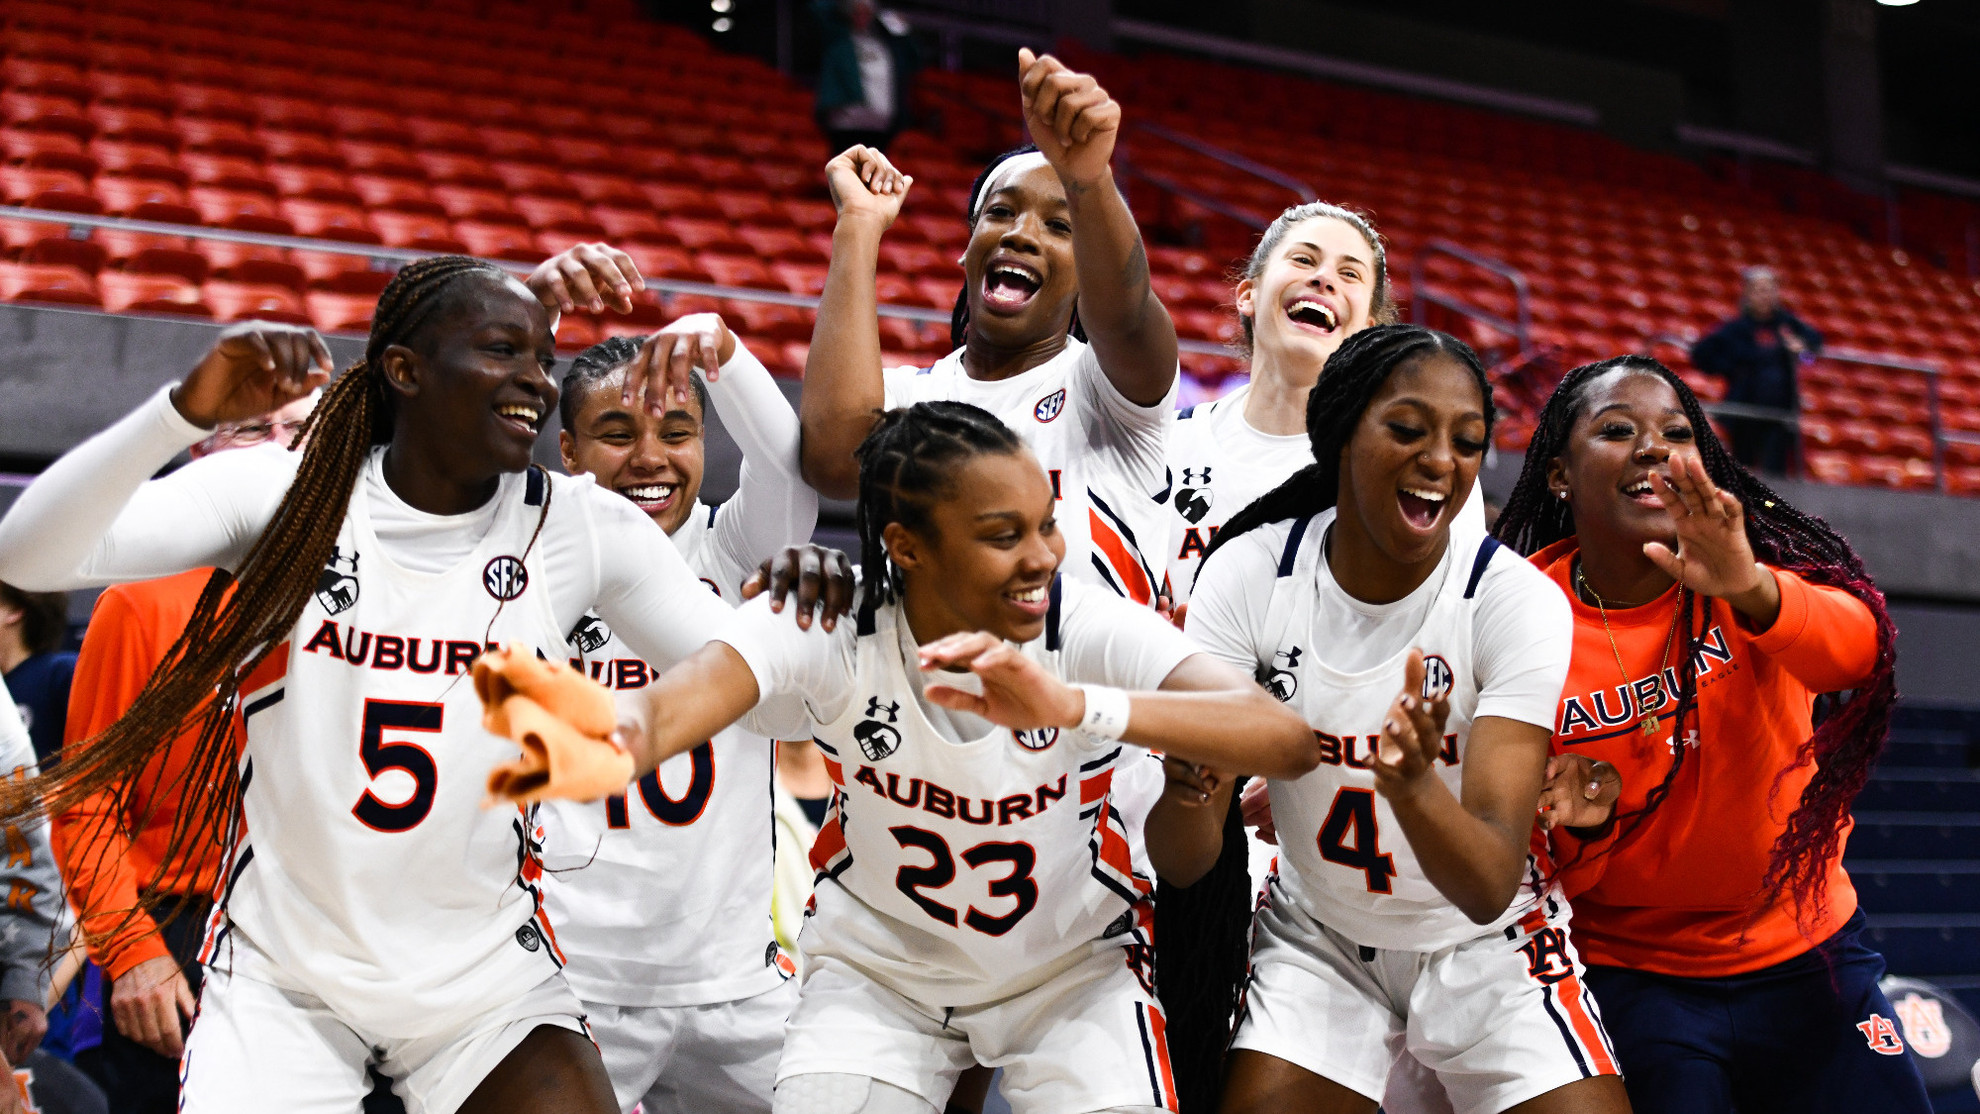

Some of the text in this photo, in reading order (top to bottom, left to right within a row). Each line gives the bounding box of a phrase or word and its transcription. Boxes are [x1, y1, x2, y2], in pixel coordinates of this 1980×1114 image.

[1036, 390, 1064, 420] SEC
[486, 557, 526, 599] SEC
[303, 619, 499, 676] AUBUR
[1701, 663, 1740, 688] EAGLE
[1422, 657, 1450, 698] EC
[350, 697, 444, 833] 5
[853, 764, 1068, 826] AUBURN
[1317, 787, 1397, 895] 4
[888, 824, 1039, 937] 23
